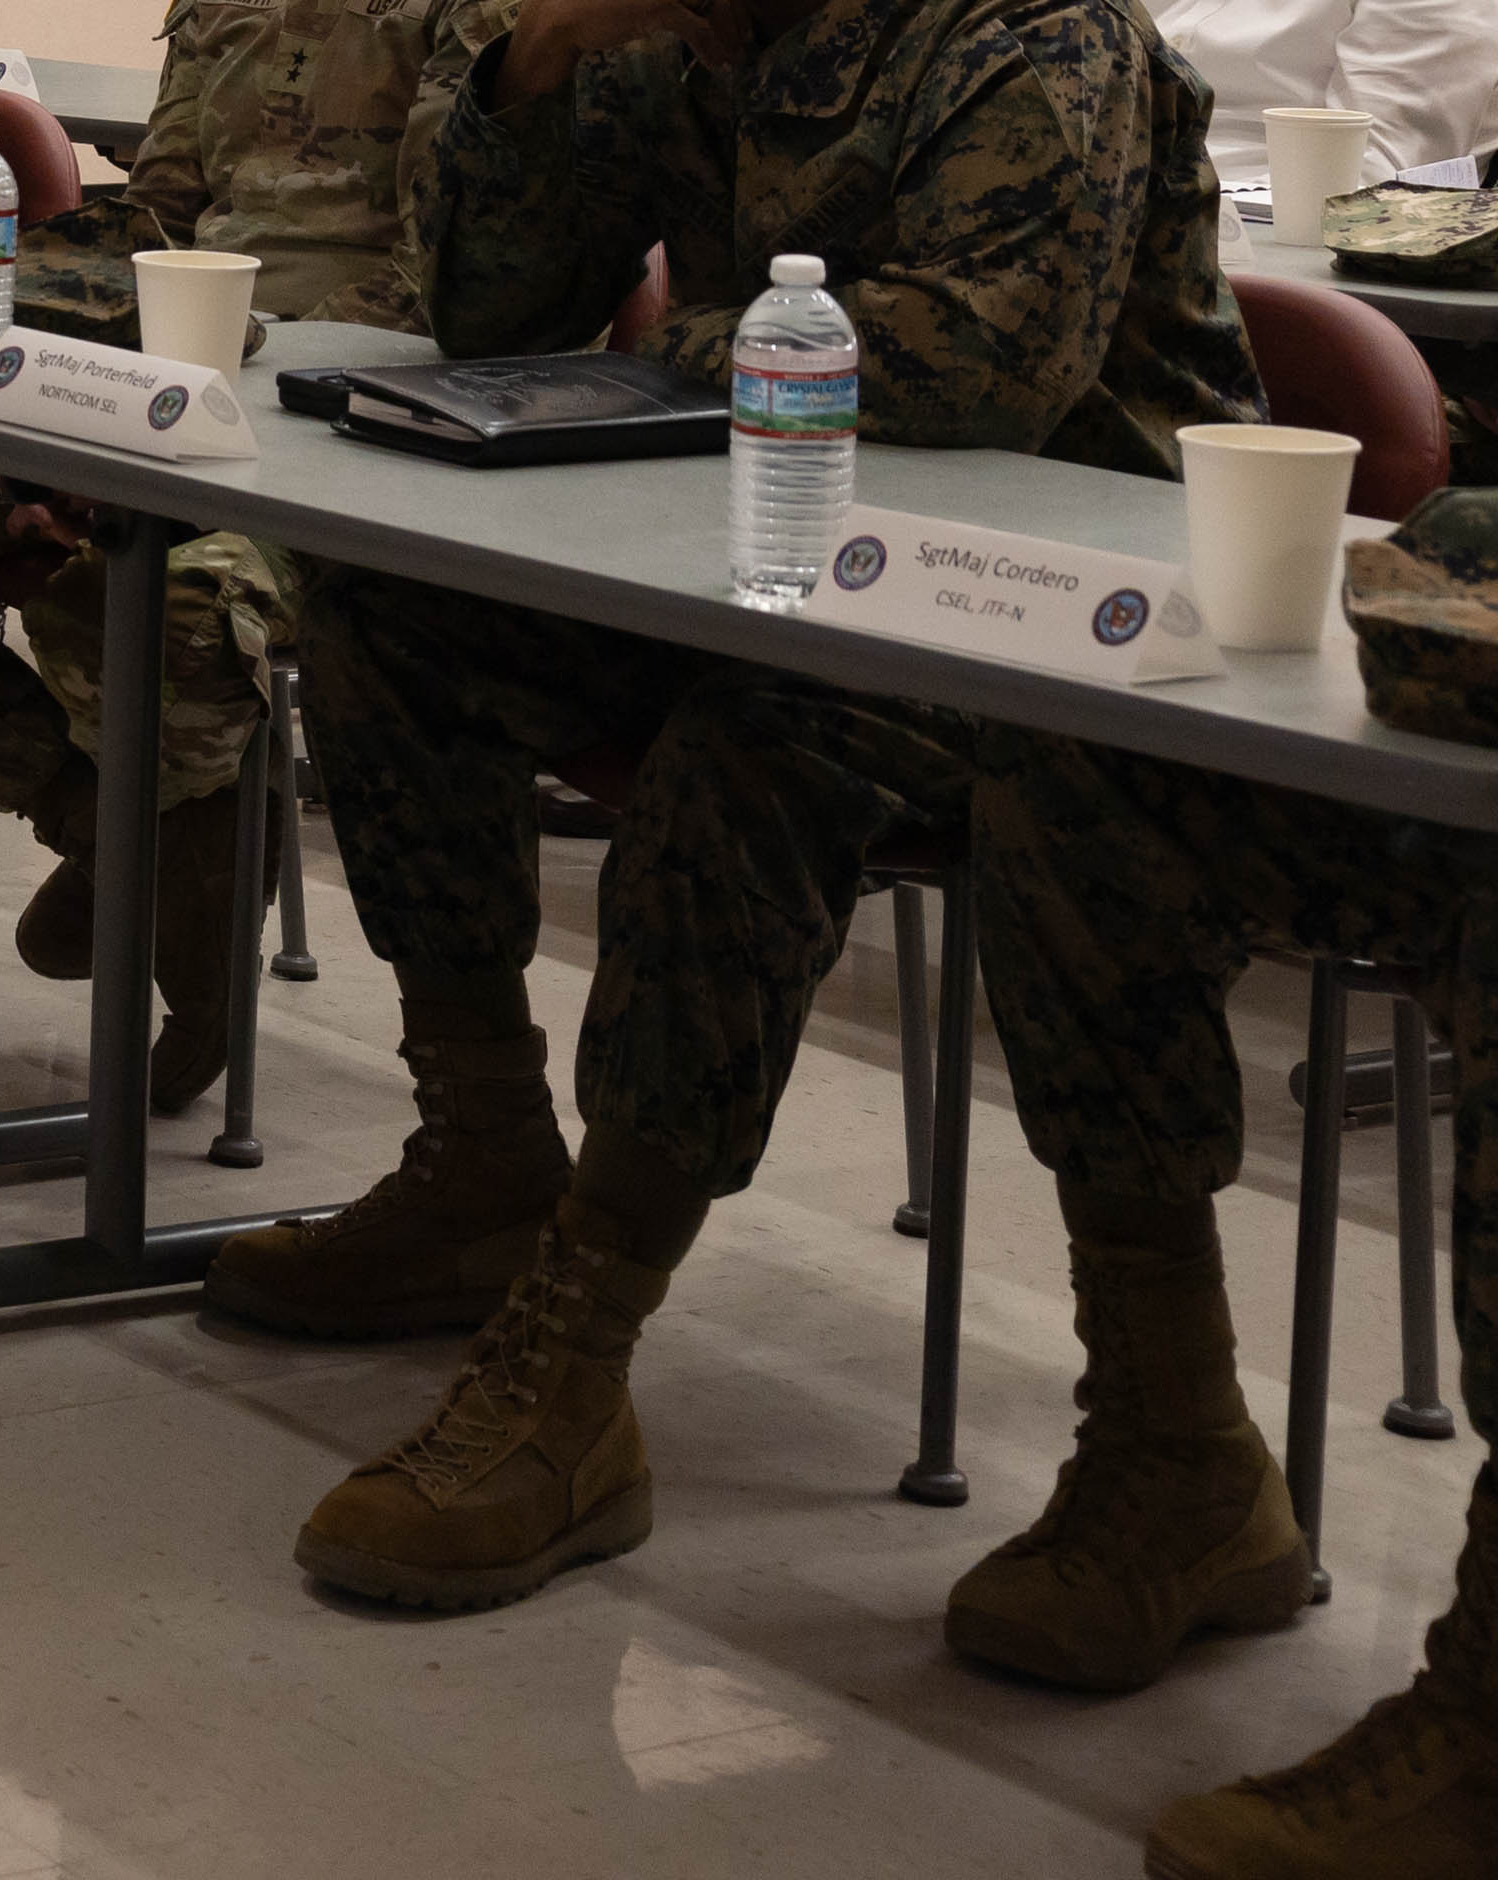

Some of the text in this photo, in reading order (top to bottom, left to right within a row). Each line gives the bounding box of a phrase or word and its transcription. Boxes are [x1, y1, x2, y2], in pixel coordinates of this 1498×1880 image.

[34, 349, 158, 390] SgtMaj Porterfield
[39, 383, 118, 415] NORTHCOM SEL
[778, 382, 823, 393] CRYSTAL
[914, 542, 1079, 592] SgtMaj Cordero
[935, 589, 1027, 623] CSEL, JTF-N
